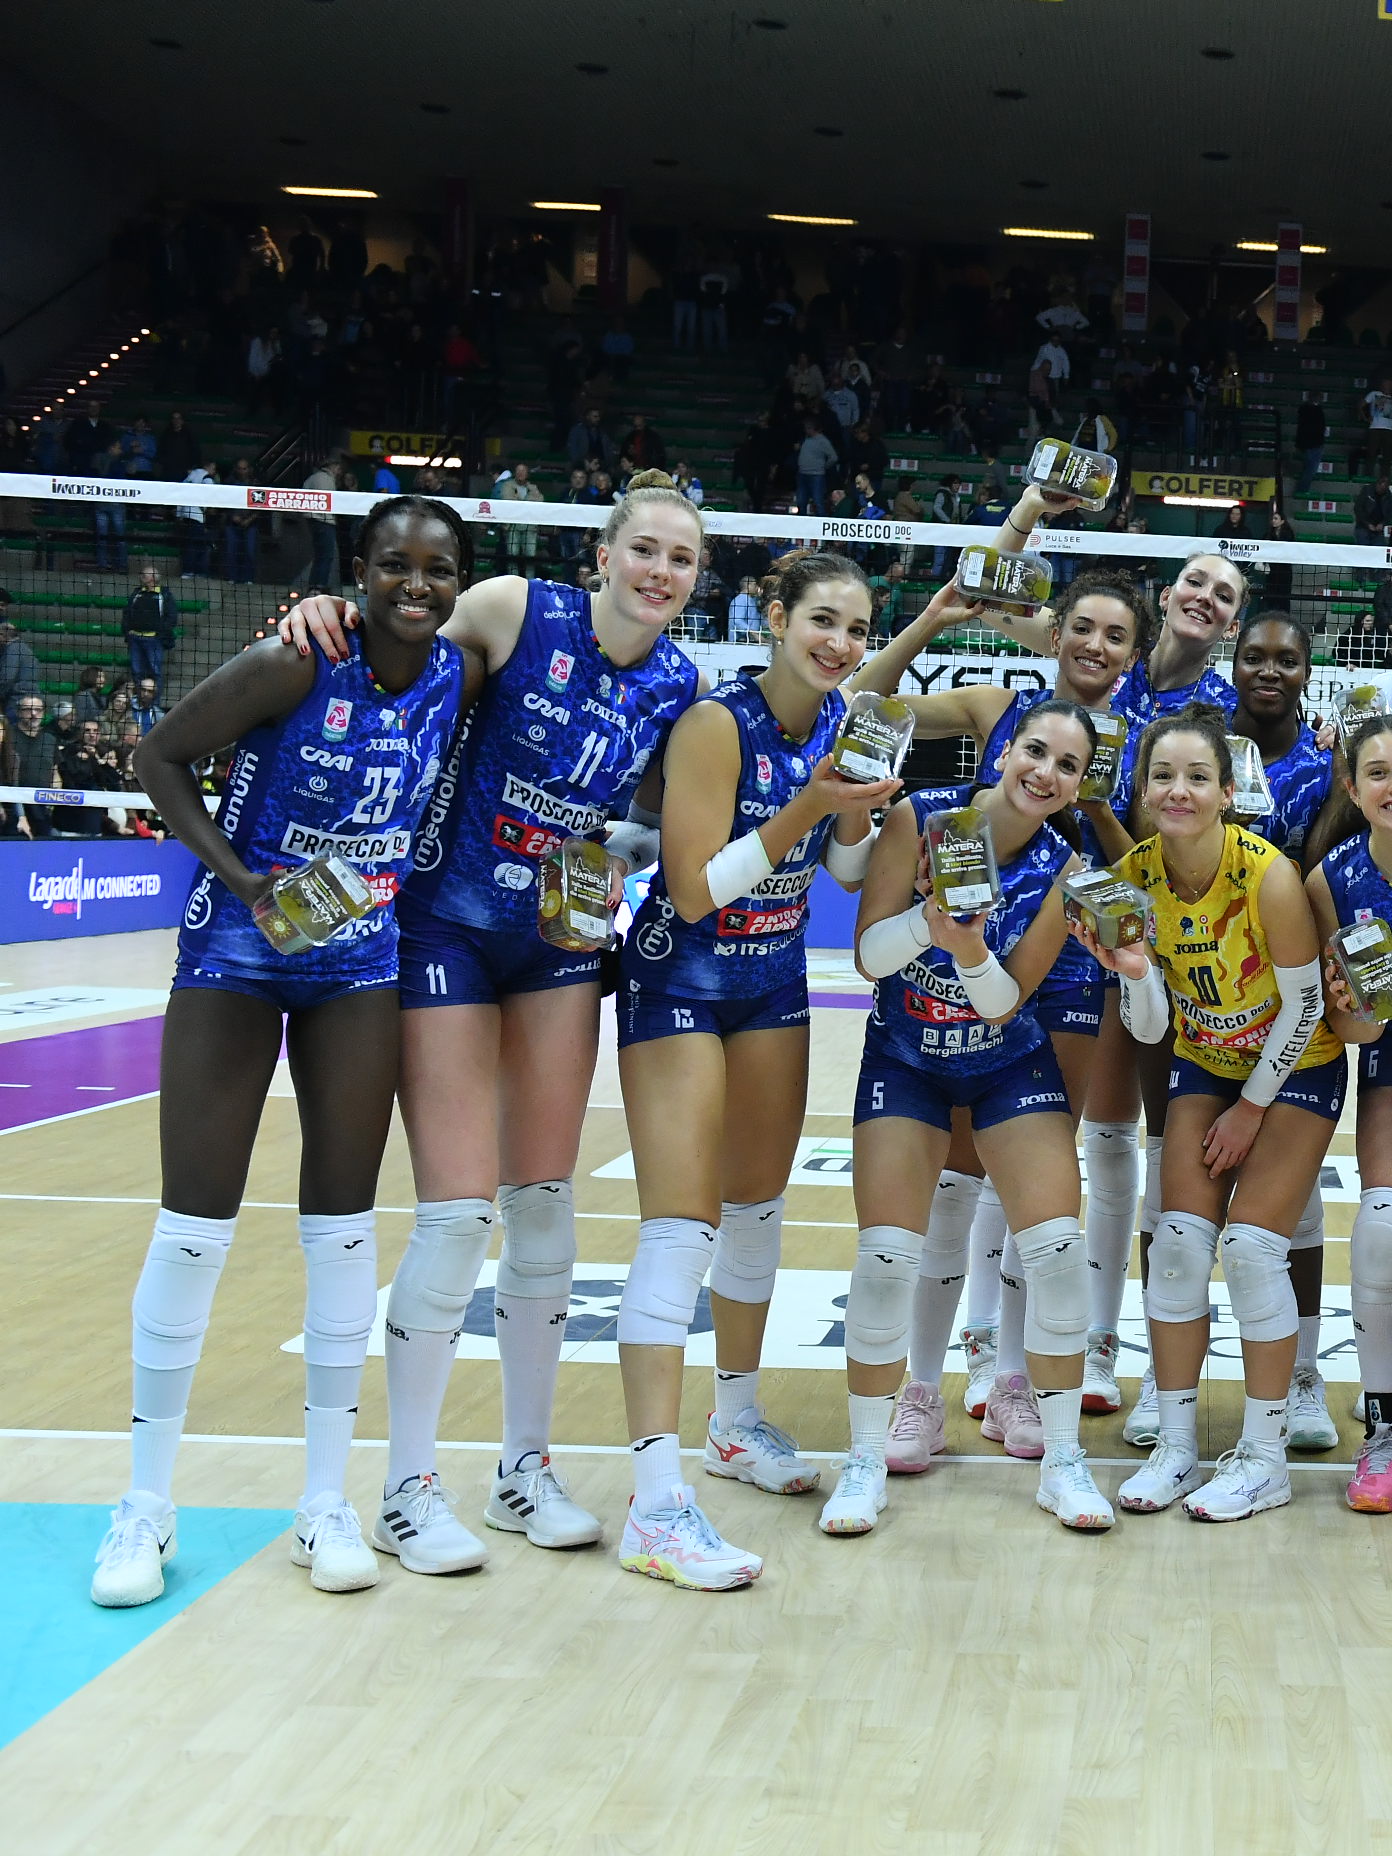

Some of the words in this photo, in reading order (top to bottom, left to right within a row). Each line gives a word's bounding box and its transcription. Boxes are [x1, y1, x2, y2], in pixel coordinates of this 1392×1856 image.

[101, 488, 142, 499] GROUP
[268, 491, 328, 501] ANTONIO
[1148, 474, 1258, 497] COLFERT
[268, 499, 328, 511] CARRARO
[821, 521, 891, 540] PROSECCO
[894, 525, 912, 540] DOC
[1045, 535, 1081, 543] PULSEE
[1229, 550, 1252, 559] Volley
[523, 692, 571, 726] CRAI
[580, 697, 628, 728] Joma
[853, 716, 901, 739] MATERA
[511, 733, 550, 757] LIQUIGAS
[229, 749, 247, 786] BANCA
[300, 746, 354, 772] CRAI
[567, 730, 610, 788] 11
[37, 792, 82, 803] FINECO
[293, 786, 335, 803] LIQUIGAS
[352, 767, 402, 824] 23
[508, 779, 594, 832] PROSECCO
[919, 790, 958, 800] BAXI
[937, 841, 983, 854] MATERA
[96, 873, 162, 899] CONNECTED
[569, 869, 607, 889] MATERA
[1173, 940, 1220, 955] Joma
[425, 962, 448, 995] 11
[1187, 965, 1223, 1007] 10
[1062, 1010, 1099, 1025] Joma
[1250, 1000, 1271, 1018] DOC
[920, 1034, 1004, 1058] bergamaschi
[1367, 1049, 1380, 1078] 6
[871, 1081, 885, 1110] 5
[1016, 1091, 1065, 1109] Joma
